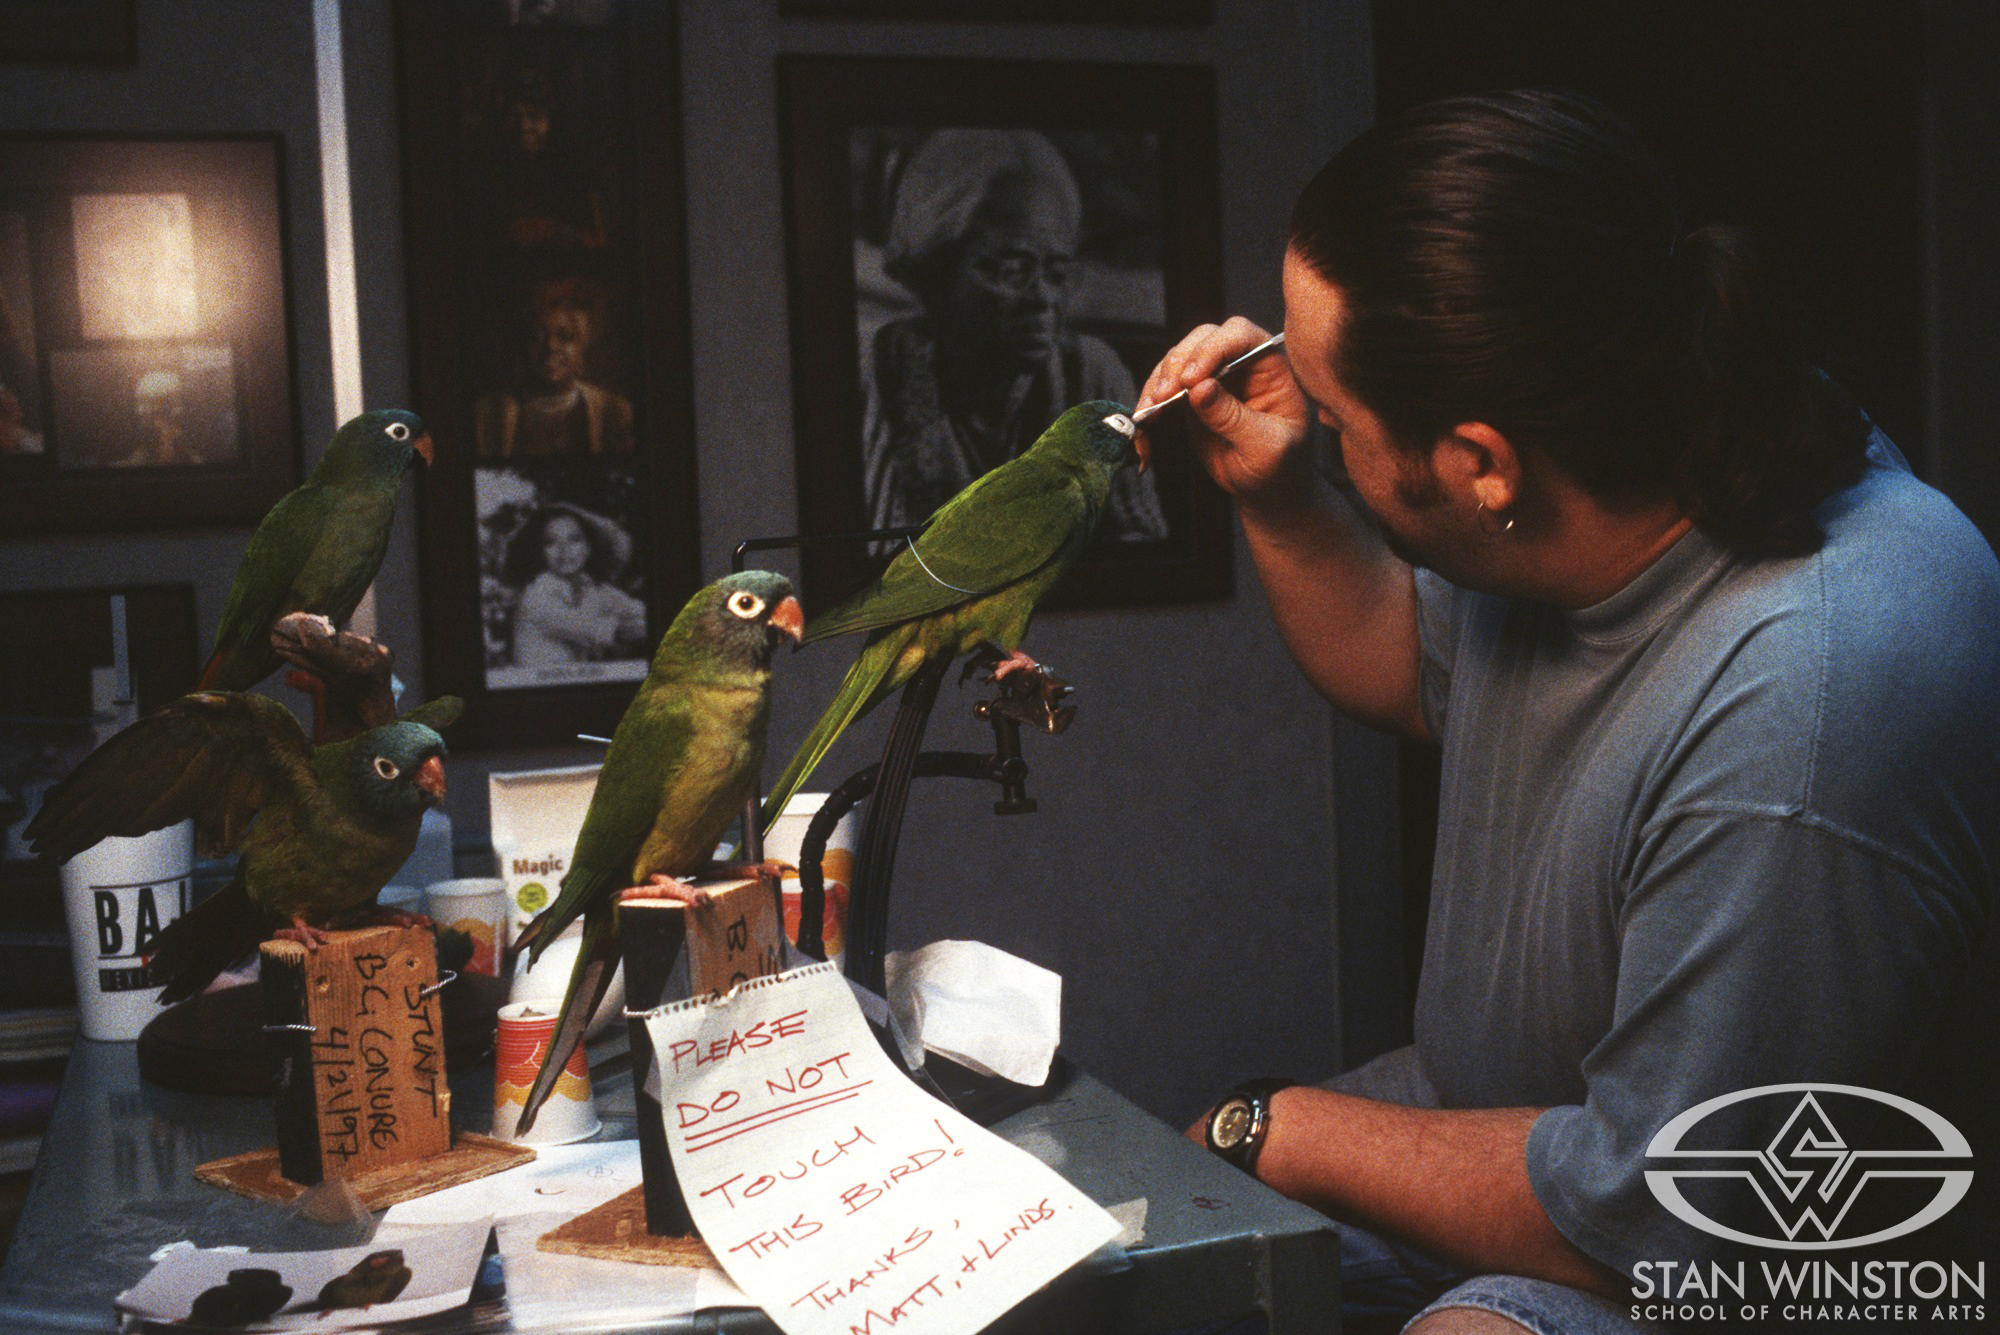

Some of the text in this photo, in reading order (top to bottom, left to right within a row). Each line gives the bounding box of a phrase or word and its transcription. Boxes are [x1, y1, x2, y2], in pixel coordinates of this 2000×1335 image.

[513, 854, 563, 876] Magic
[403, 983, 438, 1118] STUNT
[669, 1009, 808, 1073] PLEASE
[359, 1027, 399, 1150] CONURE
[676, 1052, 850, 1129] DO NOT
[700, 1126, 876, 1208] TOUCH
[728, 1118, 965, 1259] THIS BIRD!
